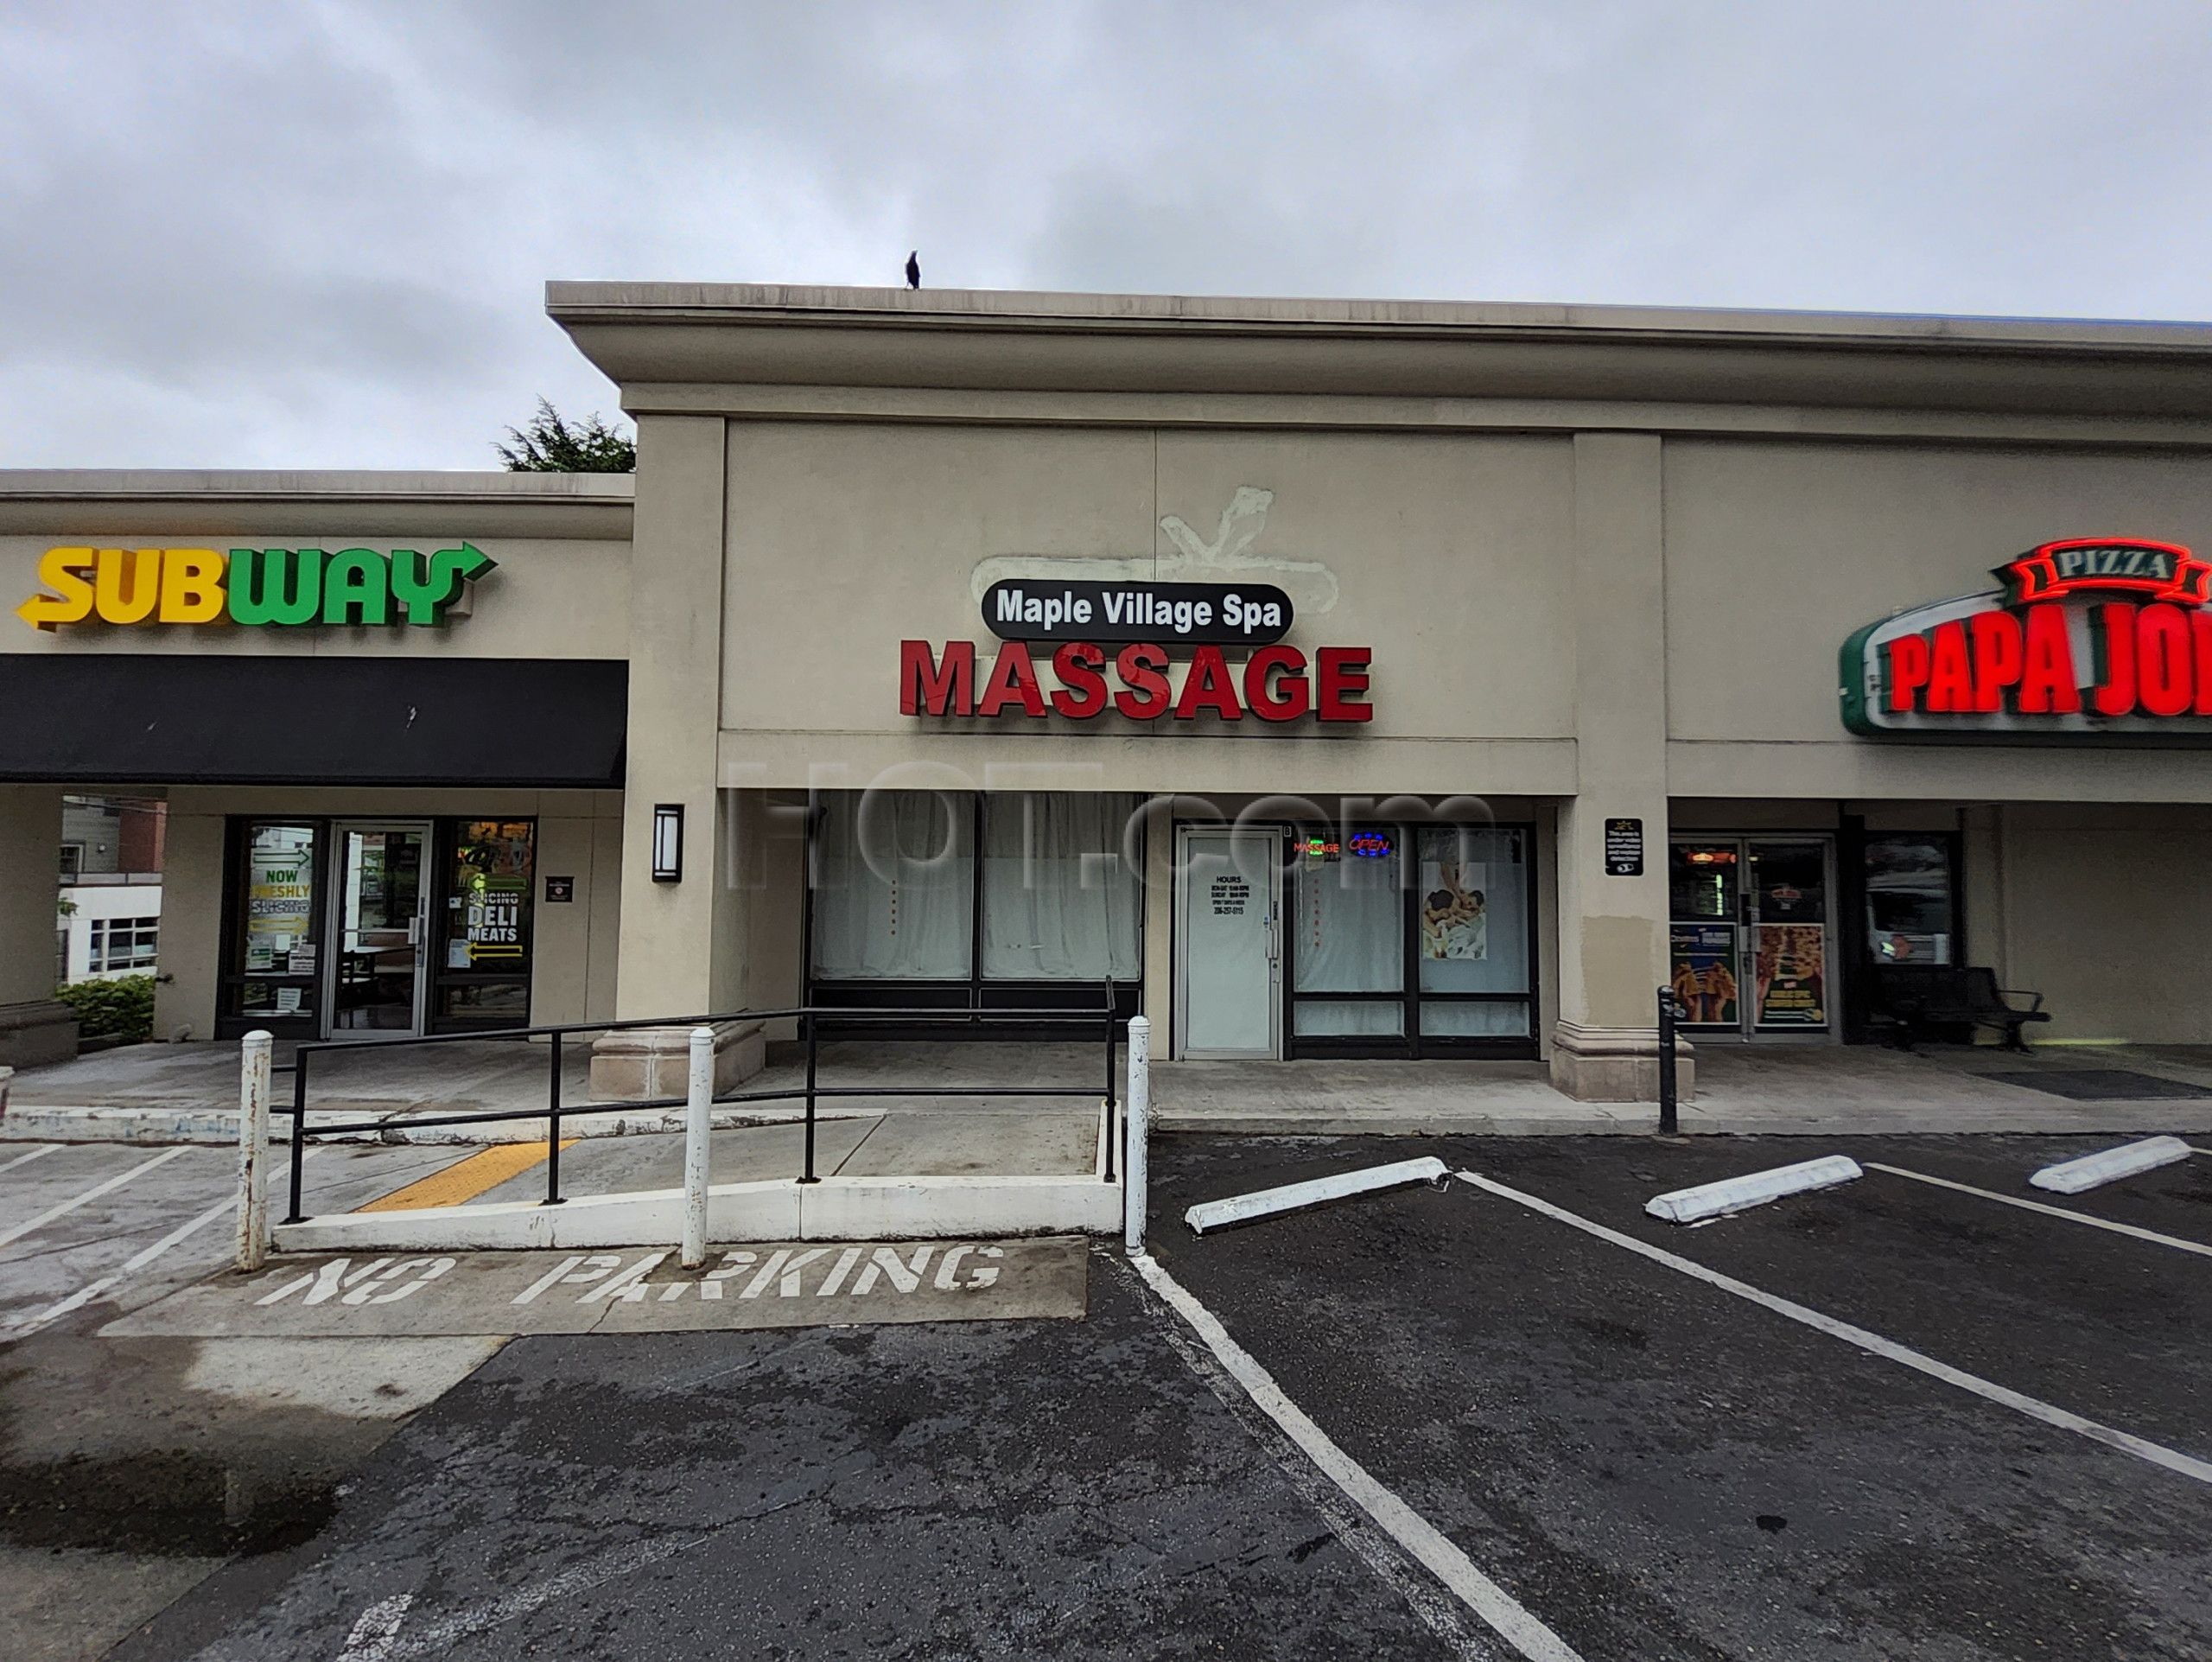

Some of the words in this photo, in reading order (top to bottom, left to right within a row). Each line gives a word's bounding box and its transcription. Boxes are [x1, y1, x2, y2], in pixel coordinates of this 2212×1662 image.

[2058, 549, 2171, 579] PIZZA
[16, 541, 499, 632] SUBWAY
[995, 589, 1092, 630] Maple
[1102, 592, 1212, 633] Village
[1223, 594, 1281, 634] Spa
[1889, 603, 2081, 714] PAPA
[899, 640, 1374, 723] MASSAGE
[1294, 843, 1340, 853] MASSAGE
[1349, 838, 1389, 851] OPEN
[265, 869, 299, 882] NOW
[251, 885, 310, 898] ESHLY
[467, 906, 518, 926] DELI
[467, 927, 518, 942] MEATS
[253, 1258, 456, 1305] NO
[509, 1245, 1004, 1304] PARKING
